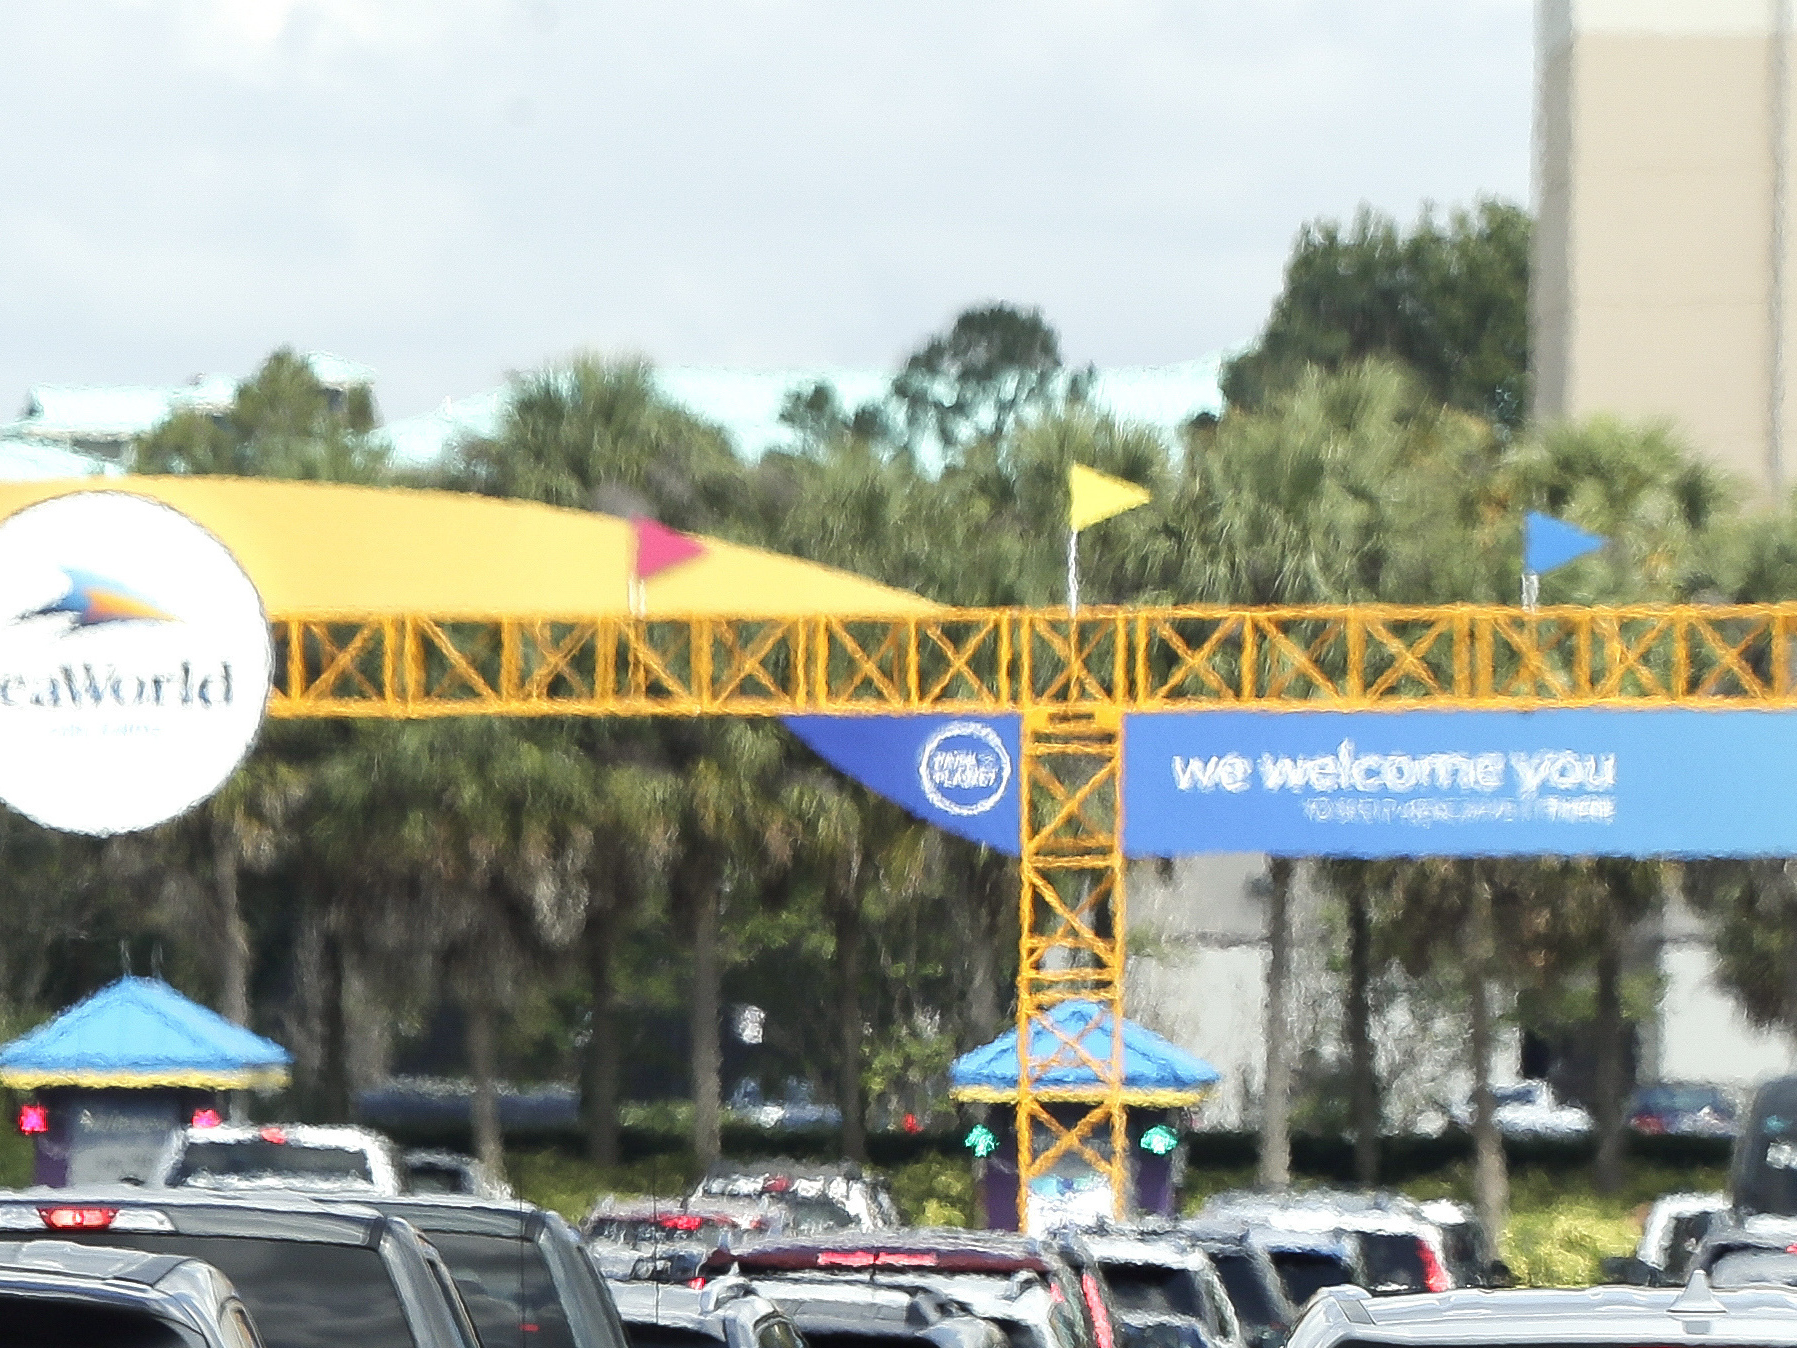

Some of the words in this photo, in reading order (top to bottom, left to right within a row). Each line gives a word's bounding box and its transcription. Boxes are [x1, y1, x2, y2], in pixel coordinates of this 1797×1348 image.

[1170, 751, 1254, 793] we
[1257, 737, 1505, 794] welcome
[1507, 748, 1618, 801] you
